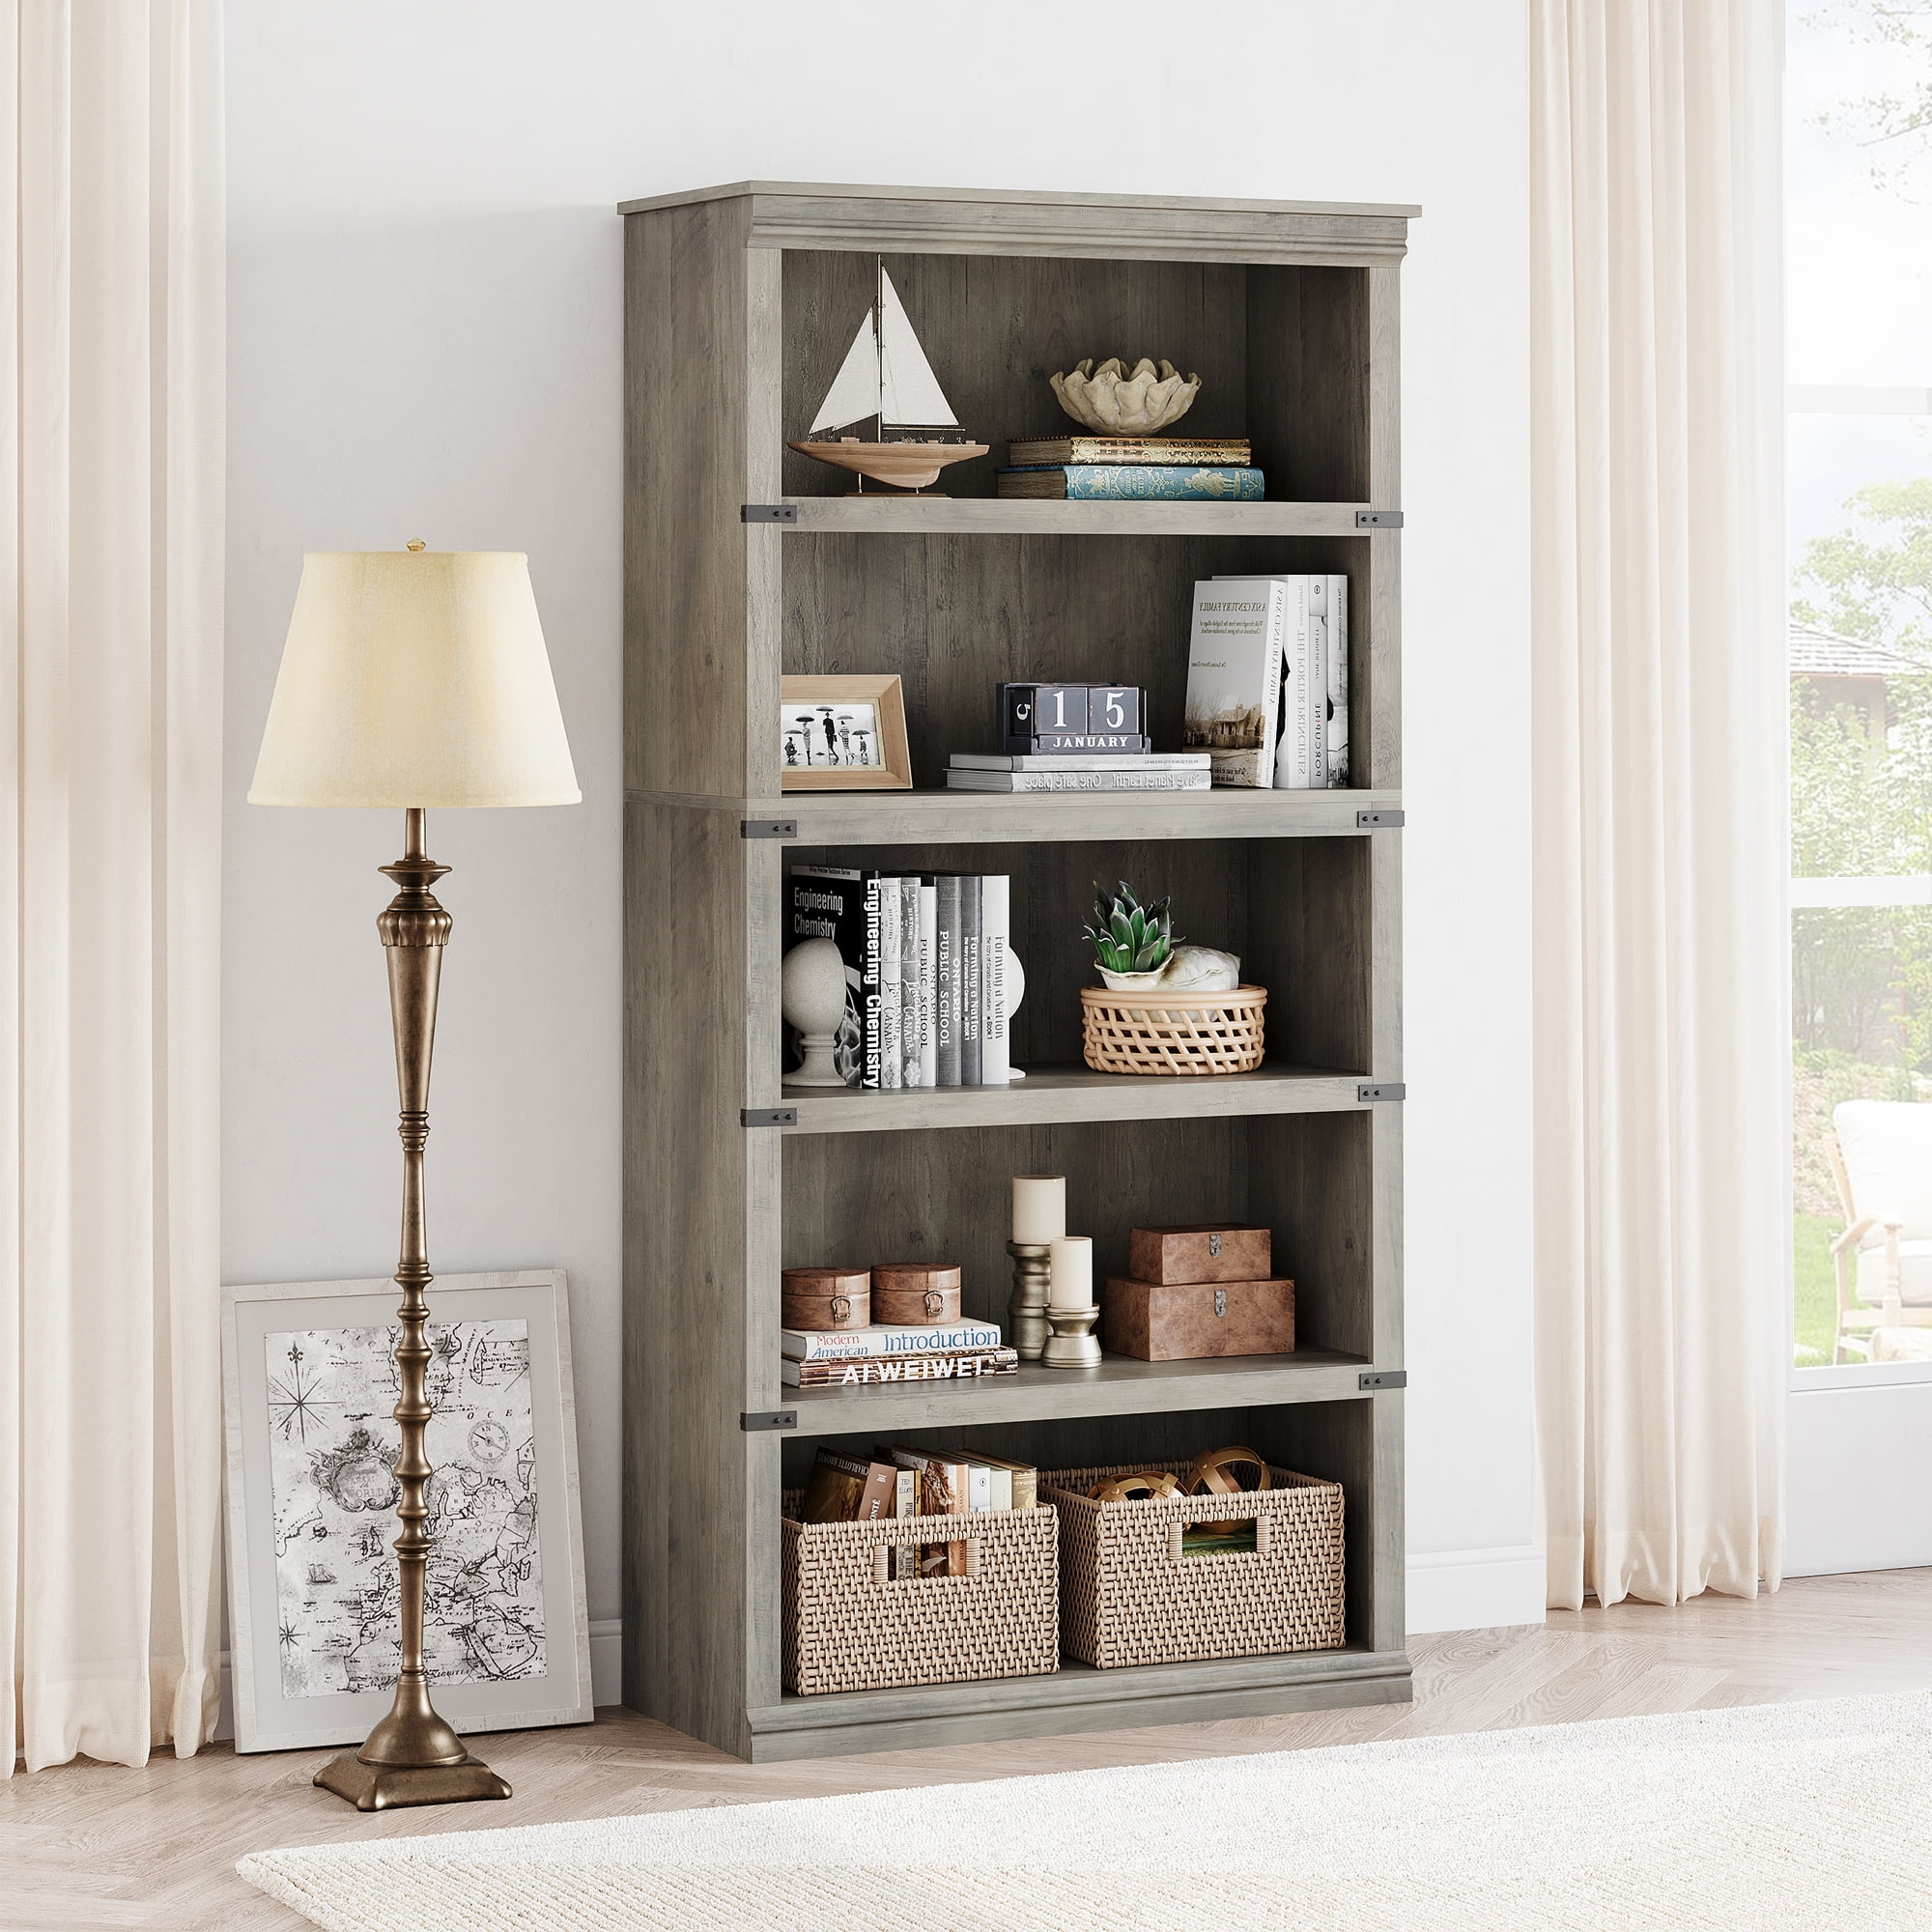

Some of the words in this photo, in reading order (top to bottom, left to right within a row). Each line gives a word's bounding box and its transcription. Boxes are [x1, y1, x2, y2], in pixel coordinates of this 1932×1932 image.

[1053, 691, 1066, 727] 1
[1106, 693, 1124, 728] 5
[1053, 737, 1128, 748] JANUARY
[794, 887, 843, 916] Engineering
[794, 914, 836, 942] Chemistry
[864, 879, 881, 984] Engineering
[940, 930, 950, 981] PUBLIC
[969, 936, 979, 987] Forming
[994, 936, 1005, 986] Forming
[940, 990, 950, 1046] SCHOOL
[970, 1001, 979, 1040] Nation
[995, 1000, 1005, 1039] Nation
[864, 995, 881, 1088] Chemistry
[812, 1346, 868, 1358] American
[816, 1335, 860, 1346] Modern
[883, 1326, 998, 1351] Introduction
[876, 1355, 982, 1382] WEIWEI
[346, 1488, 384, 1498] WORLD
